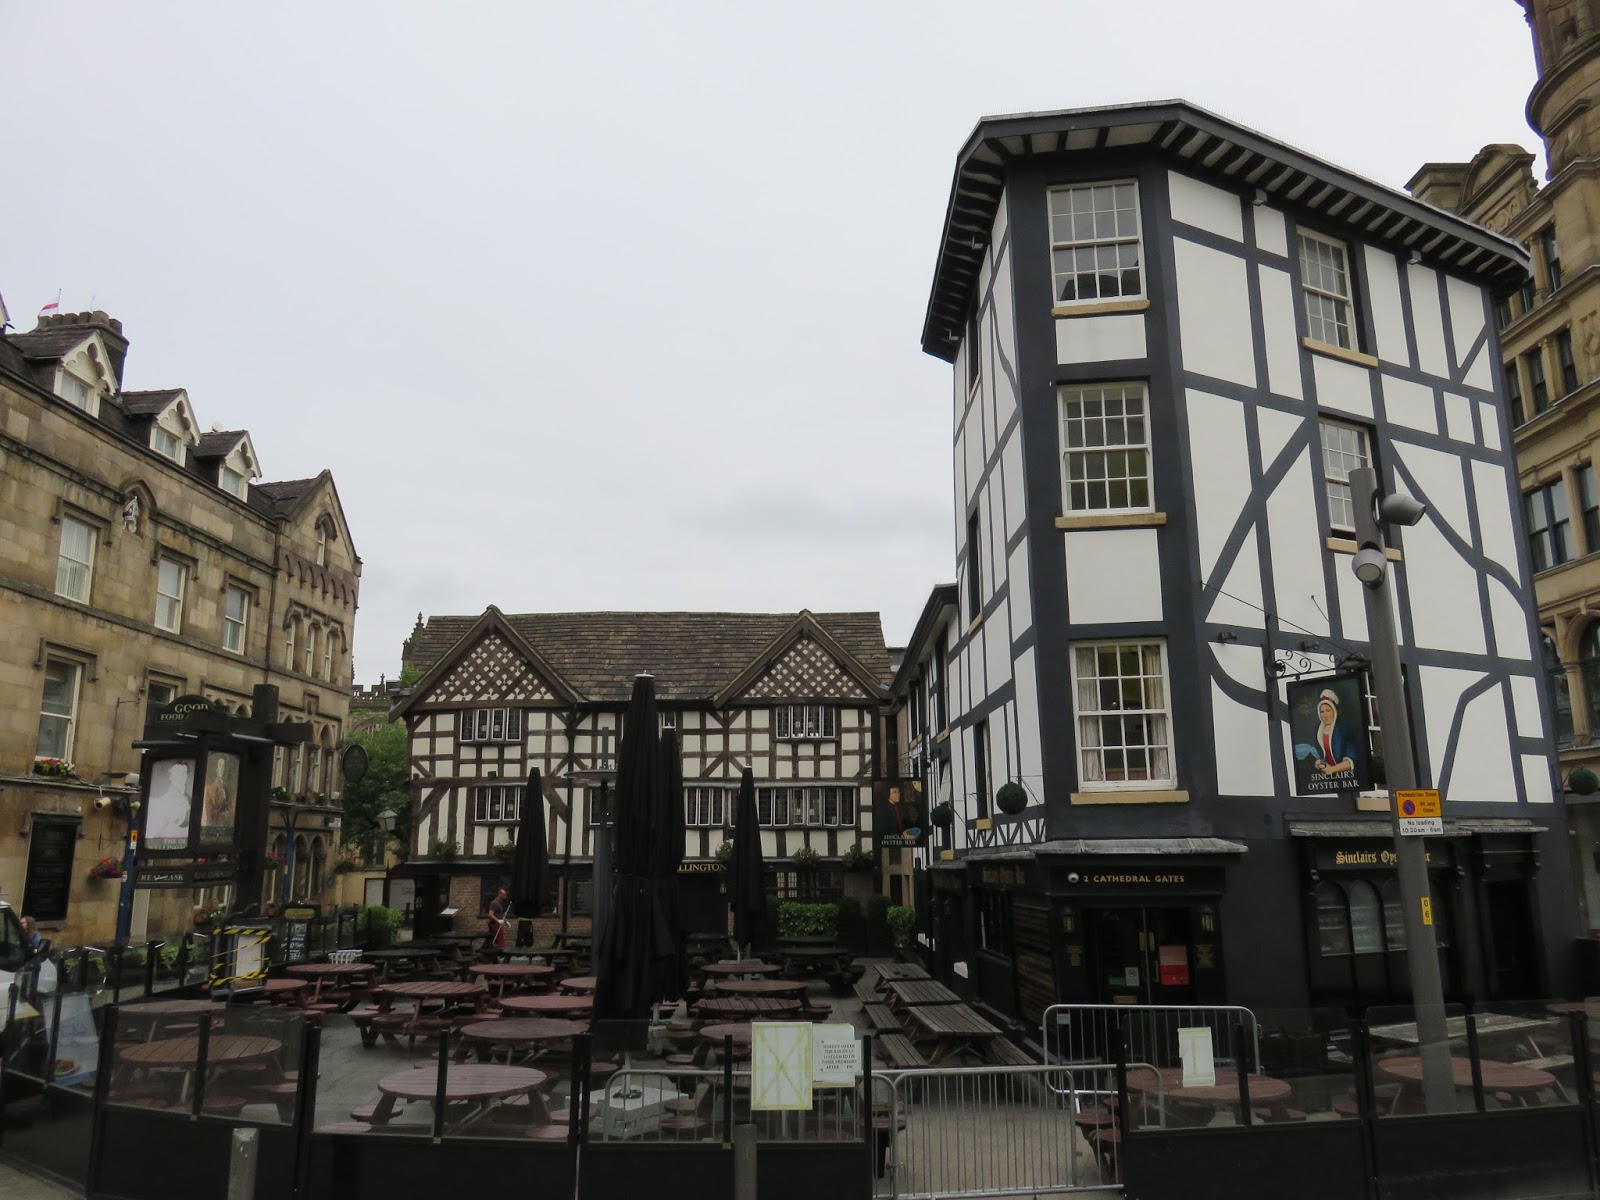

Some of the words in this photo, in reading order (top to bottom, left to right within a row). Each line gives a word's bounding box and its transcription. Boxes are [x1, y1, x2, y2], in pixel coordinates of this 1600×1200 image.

[174, 703, 209, 713] GOOD
[160, 713, 184, 721] FOOD
[1308, 781, 1340, 790] OYSTER
[1342, 779, 1360, 788] BAR
[677, 863, 728, 872] LLINGTON
[1083, 875, 1089, 883] 2
[1093, 875, 1150, 883] CATHEDRAL
[1154, 875, 1185, 883] GATES
